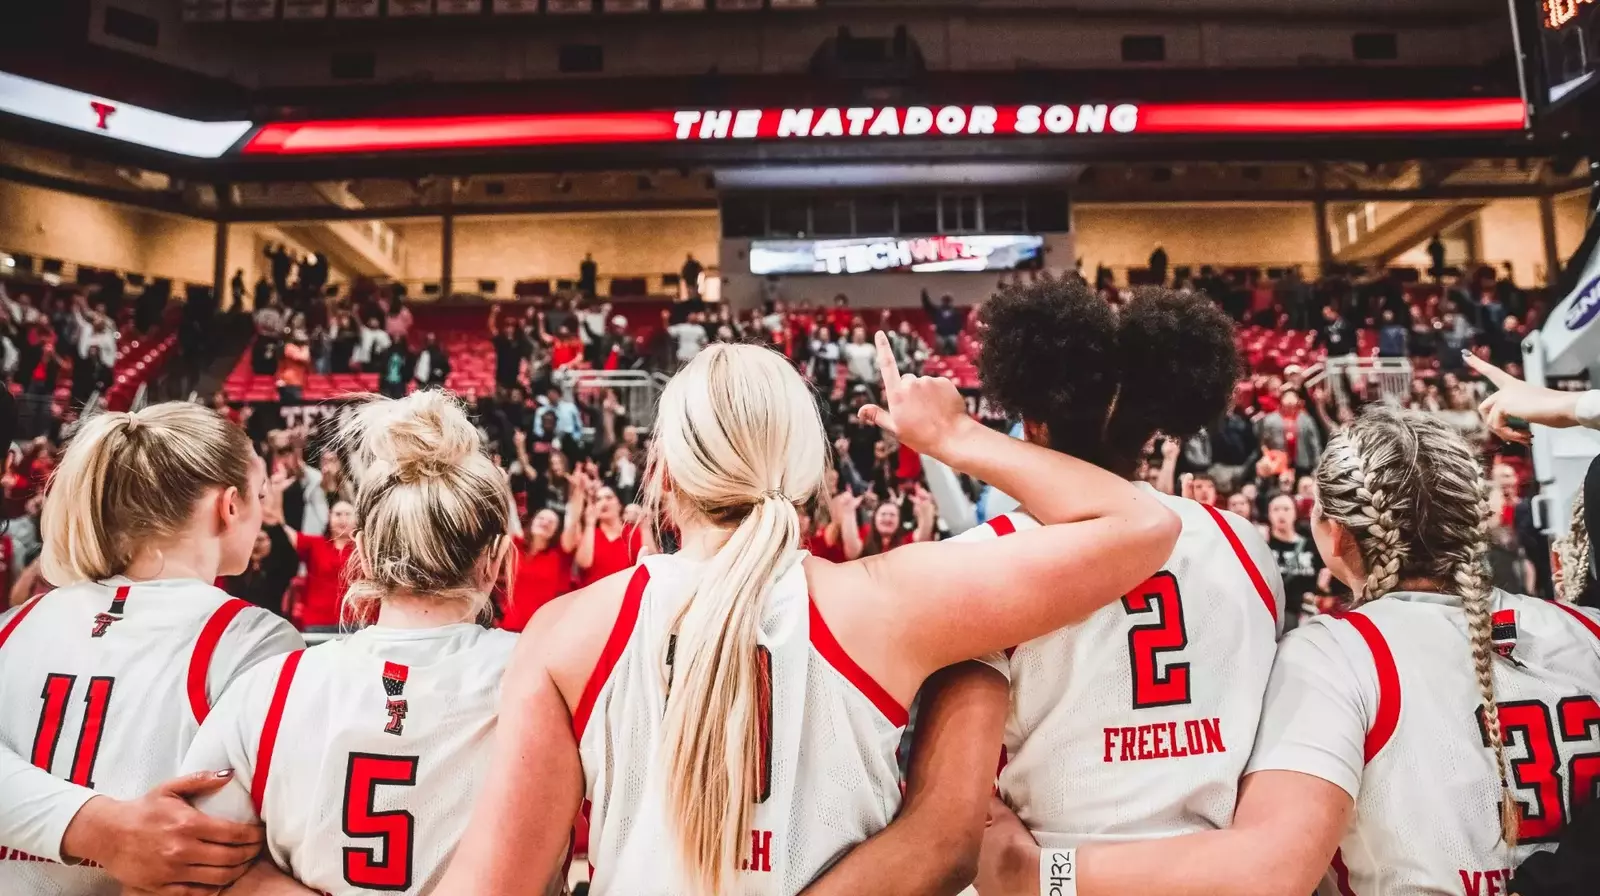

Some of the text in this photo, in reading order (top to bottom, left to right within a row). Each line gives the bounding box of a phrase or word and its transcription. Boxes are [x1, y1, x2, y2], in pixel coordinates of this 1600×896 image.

[674, 104, 1138, 139] THE MATADOR SONG
[1121, 570, 1191, 710] 2
[31, 673, 115, 790] 11
[1103, 718, 1226, 762] FREELON
[342, 752, 419, 892] 5
